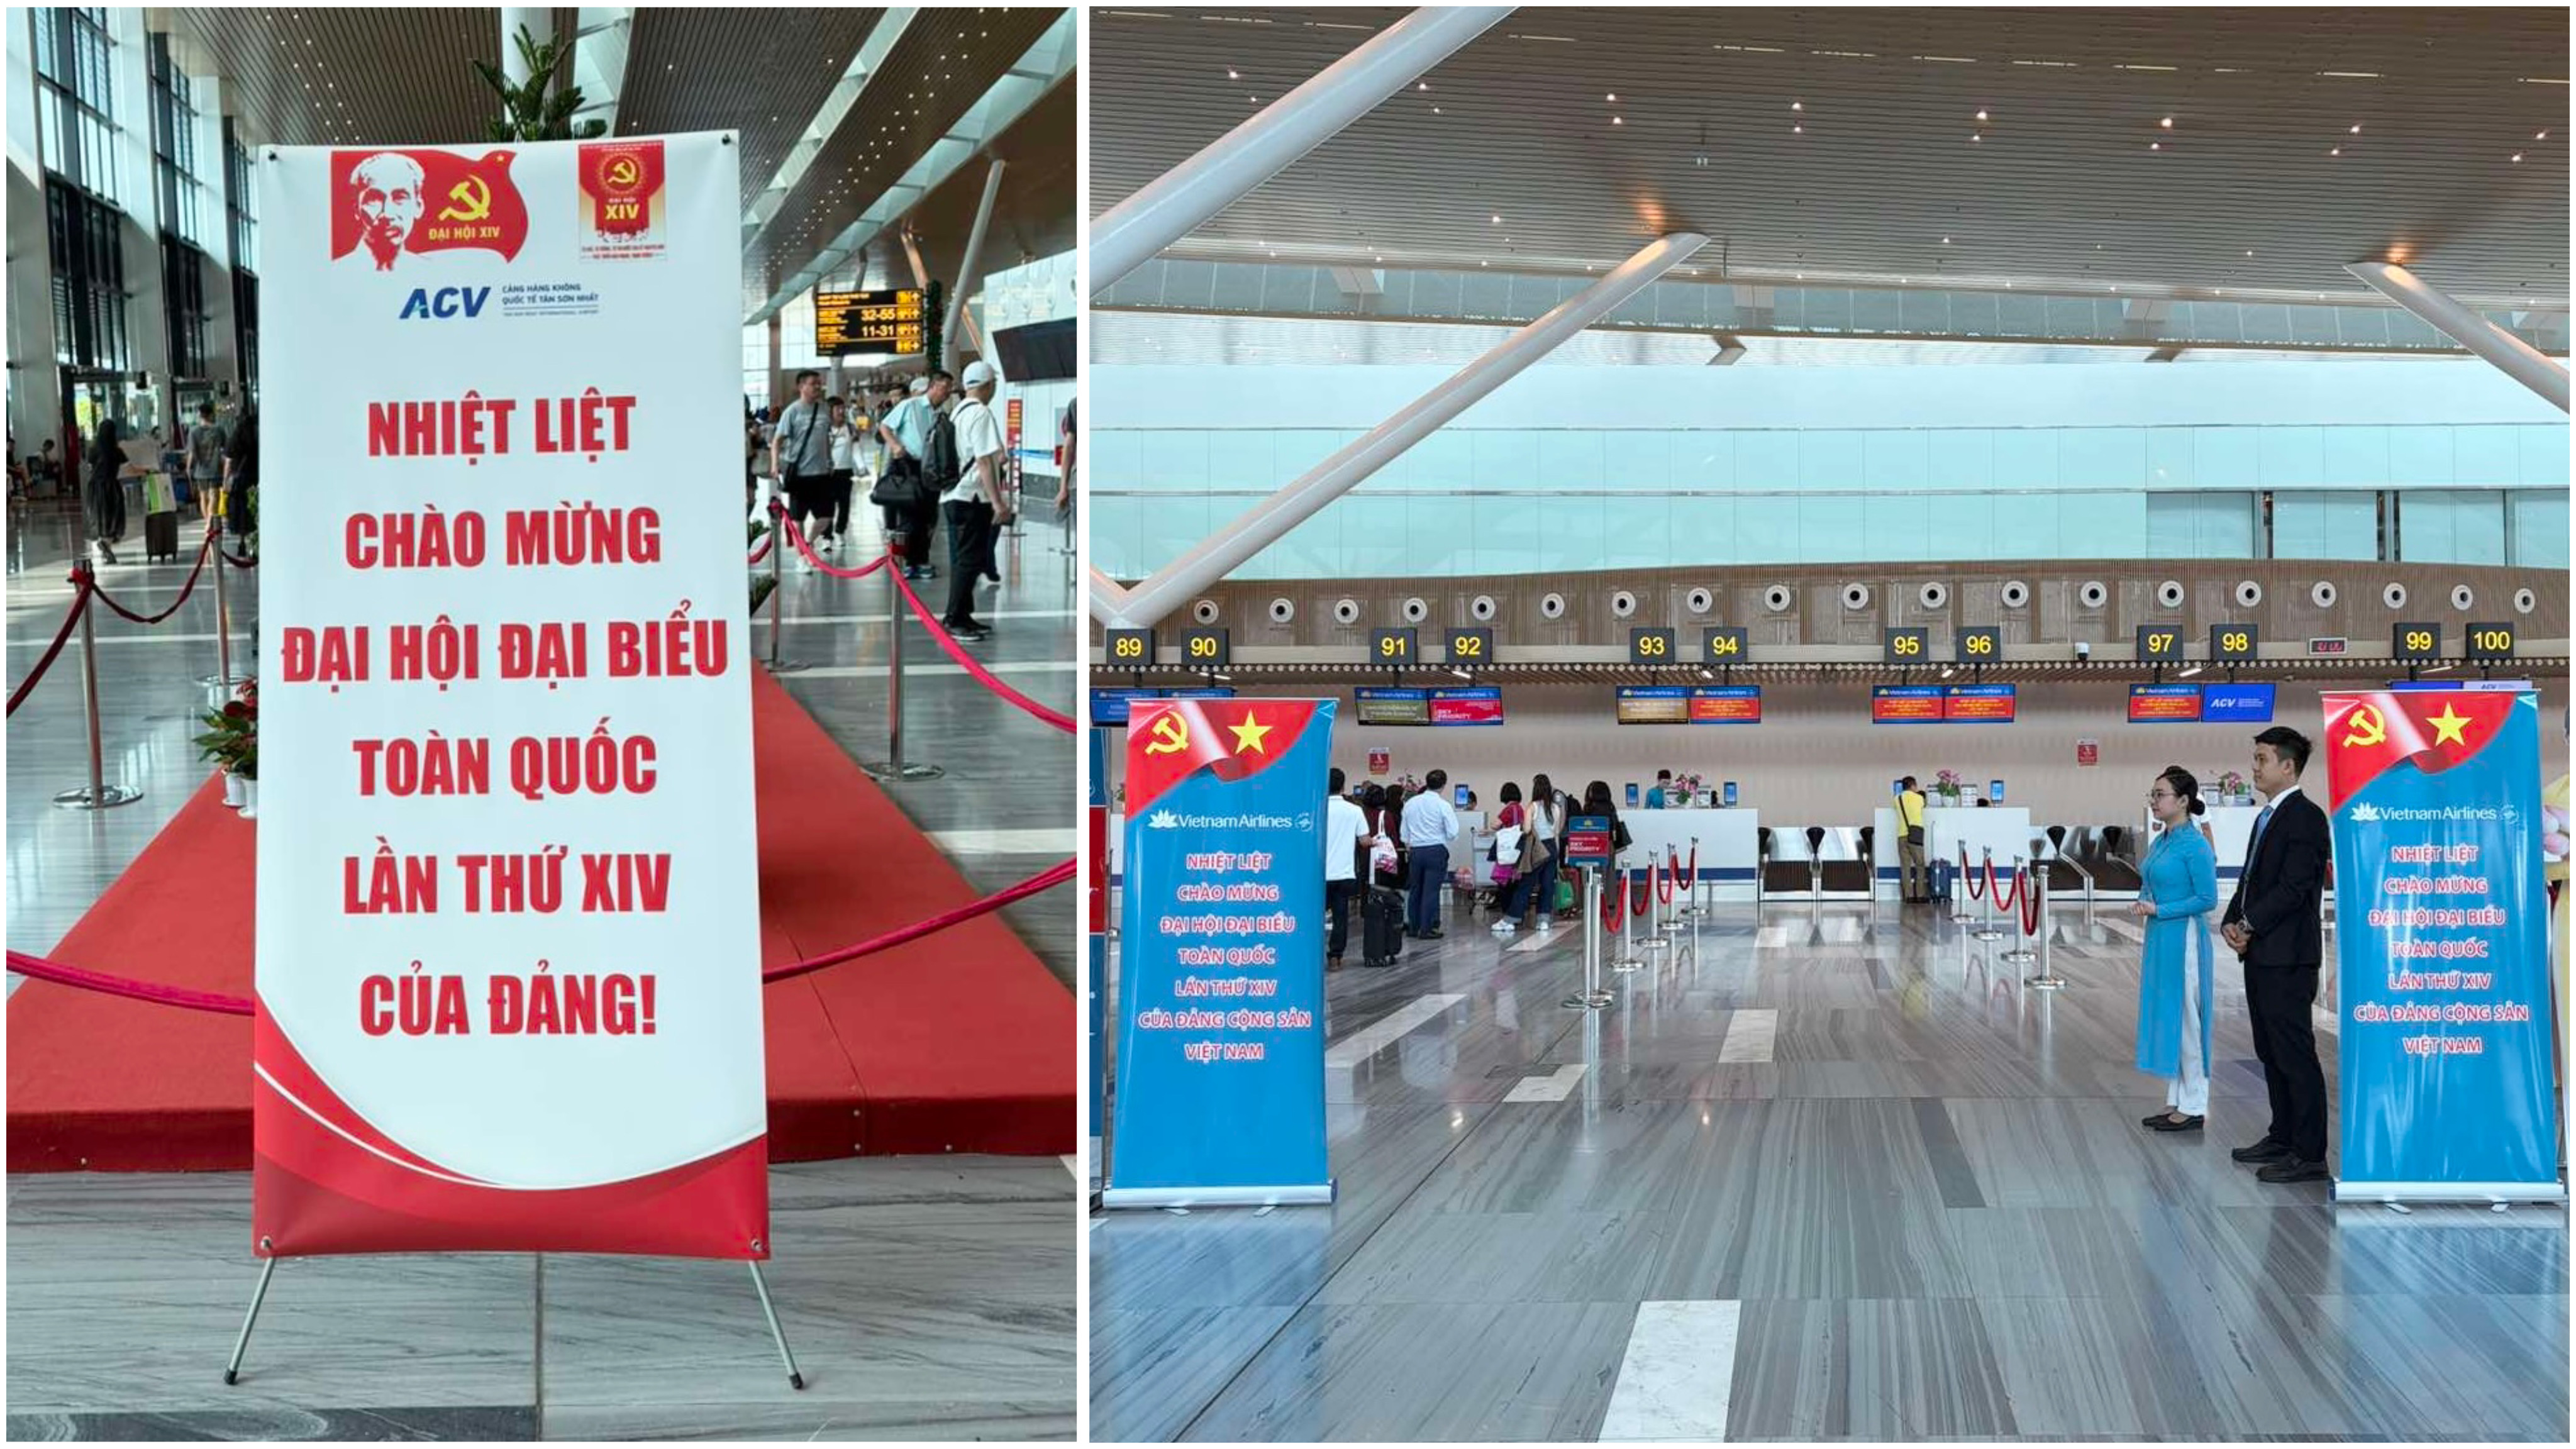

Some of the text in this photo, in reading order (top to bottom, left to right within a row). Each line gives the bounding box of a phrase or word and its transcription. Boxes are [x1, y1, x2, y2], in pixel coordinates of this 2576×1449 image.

[605, 204, 640, 219] XIV
[428, 224, 501, 242] ĐẠI HỘI XIV
[399, 286, 491, 319] ACV
[861, 325, 894, 336] 11-31
[369, 387, 636, 465] NHIỆT LIỆT
[346, 501, 660, 569] CHÀO MỪNG
[280, 599, 728, 692] ĐẠI HỘI ĐẠI BIỂU
[1114, 637, 1142, 657] 89
[1189, 636, 1216, 657] 90
[1380, 638, 1404, 657] 91
[1455, 636, 1480, 656] 92
[1639, 636, 1665, 656] 93
[1711, 638, 1738, 655] 94
[1894, 638, 1919, 655] 95
[1967, 636, 1992, 654] 96
[2148, 633, 2173, 653] 97
[2221, 633, 2248, 652] 98
[2404, 631, 2432, 651] 99
[2472, 631, 2510, 651] 100
[2211, 698, 2236, 708] ACV
[352, 716, 657, 801] TOÀN QUỐC
[1179, 814, 1292, 828] Vietnam Airlines
[2380, 806, 2497, 820] Vietnam Airlines
[1186, 850, 1272, 874] NHIỆT LIỆT
[2391, 842, 2479, 866] NHIỆT LIỆT
[344, 835, 670, 914] LẦN THỨ XIV
[1177, 882, 1225, 902] CHÀO
[2384, 875, 2433, 895] CHÀO
[1160, 915, 1190, 937] ĐẠI
[1191, 913, 1223, 937] HỘI
[1224, 915, 1255, 937] ĐẠI
[2401, 906, 2433, 930] HỘI
[2434, 909, 2465, 930] ĐẠI
[1178, 943, 1276, 967] TOÀN QUỐC
[2390, 936, 2489, 960] TOÀN QUỐC
[1248, 979, 1277, 997] XIV
[2462, 972, 2492, 989] XIV
[360, 959, 655, 1036] CỦA ĐẢNG!
[1227, 1008, 1275, 1031] CỘNG
[2443, 1002, 2491, 1025] CỘNG
[1184, 1040, 1264, 1063] VIỆT NAM
[2402, 1034, 2482, 1057] VIỆT NAM
